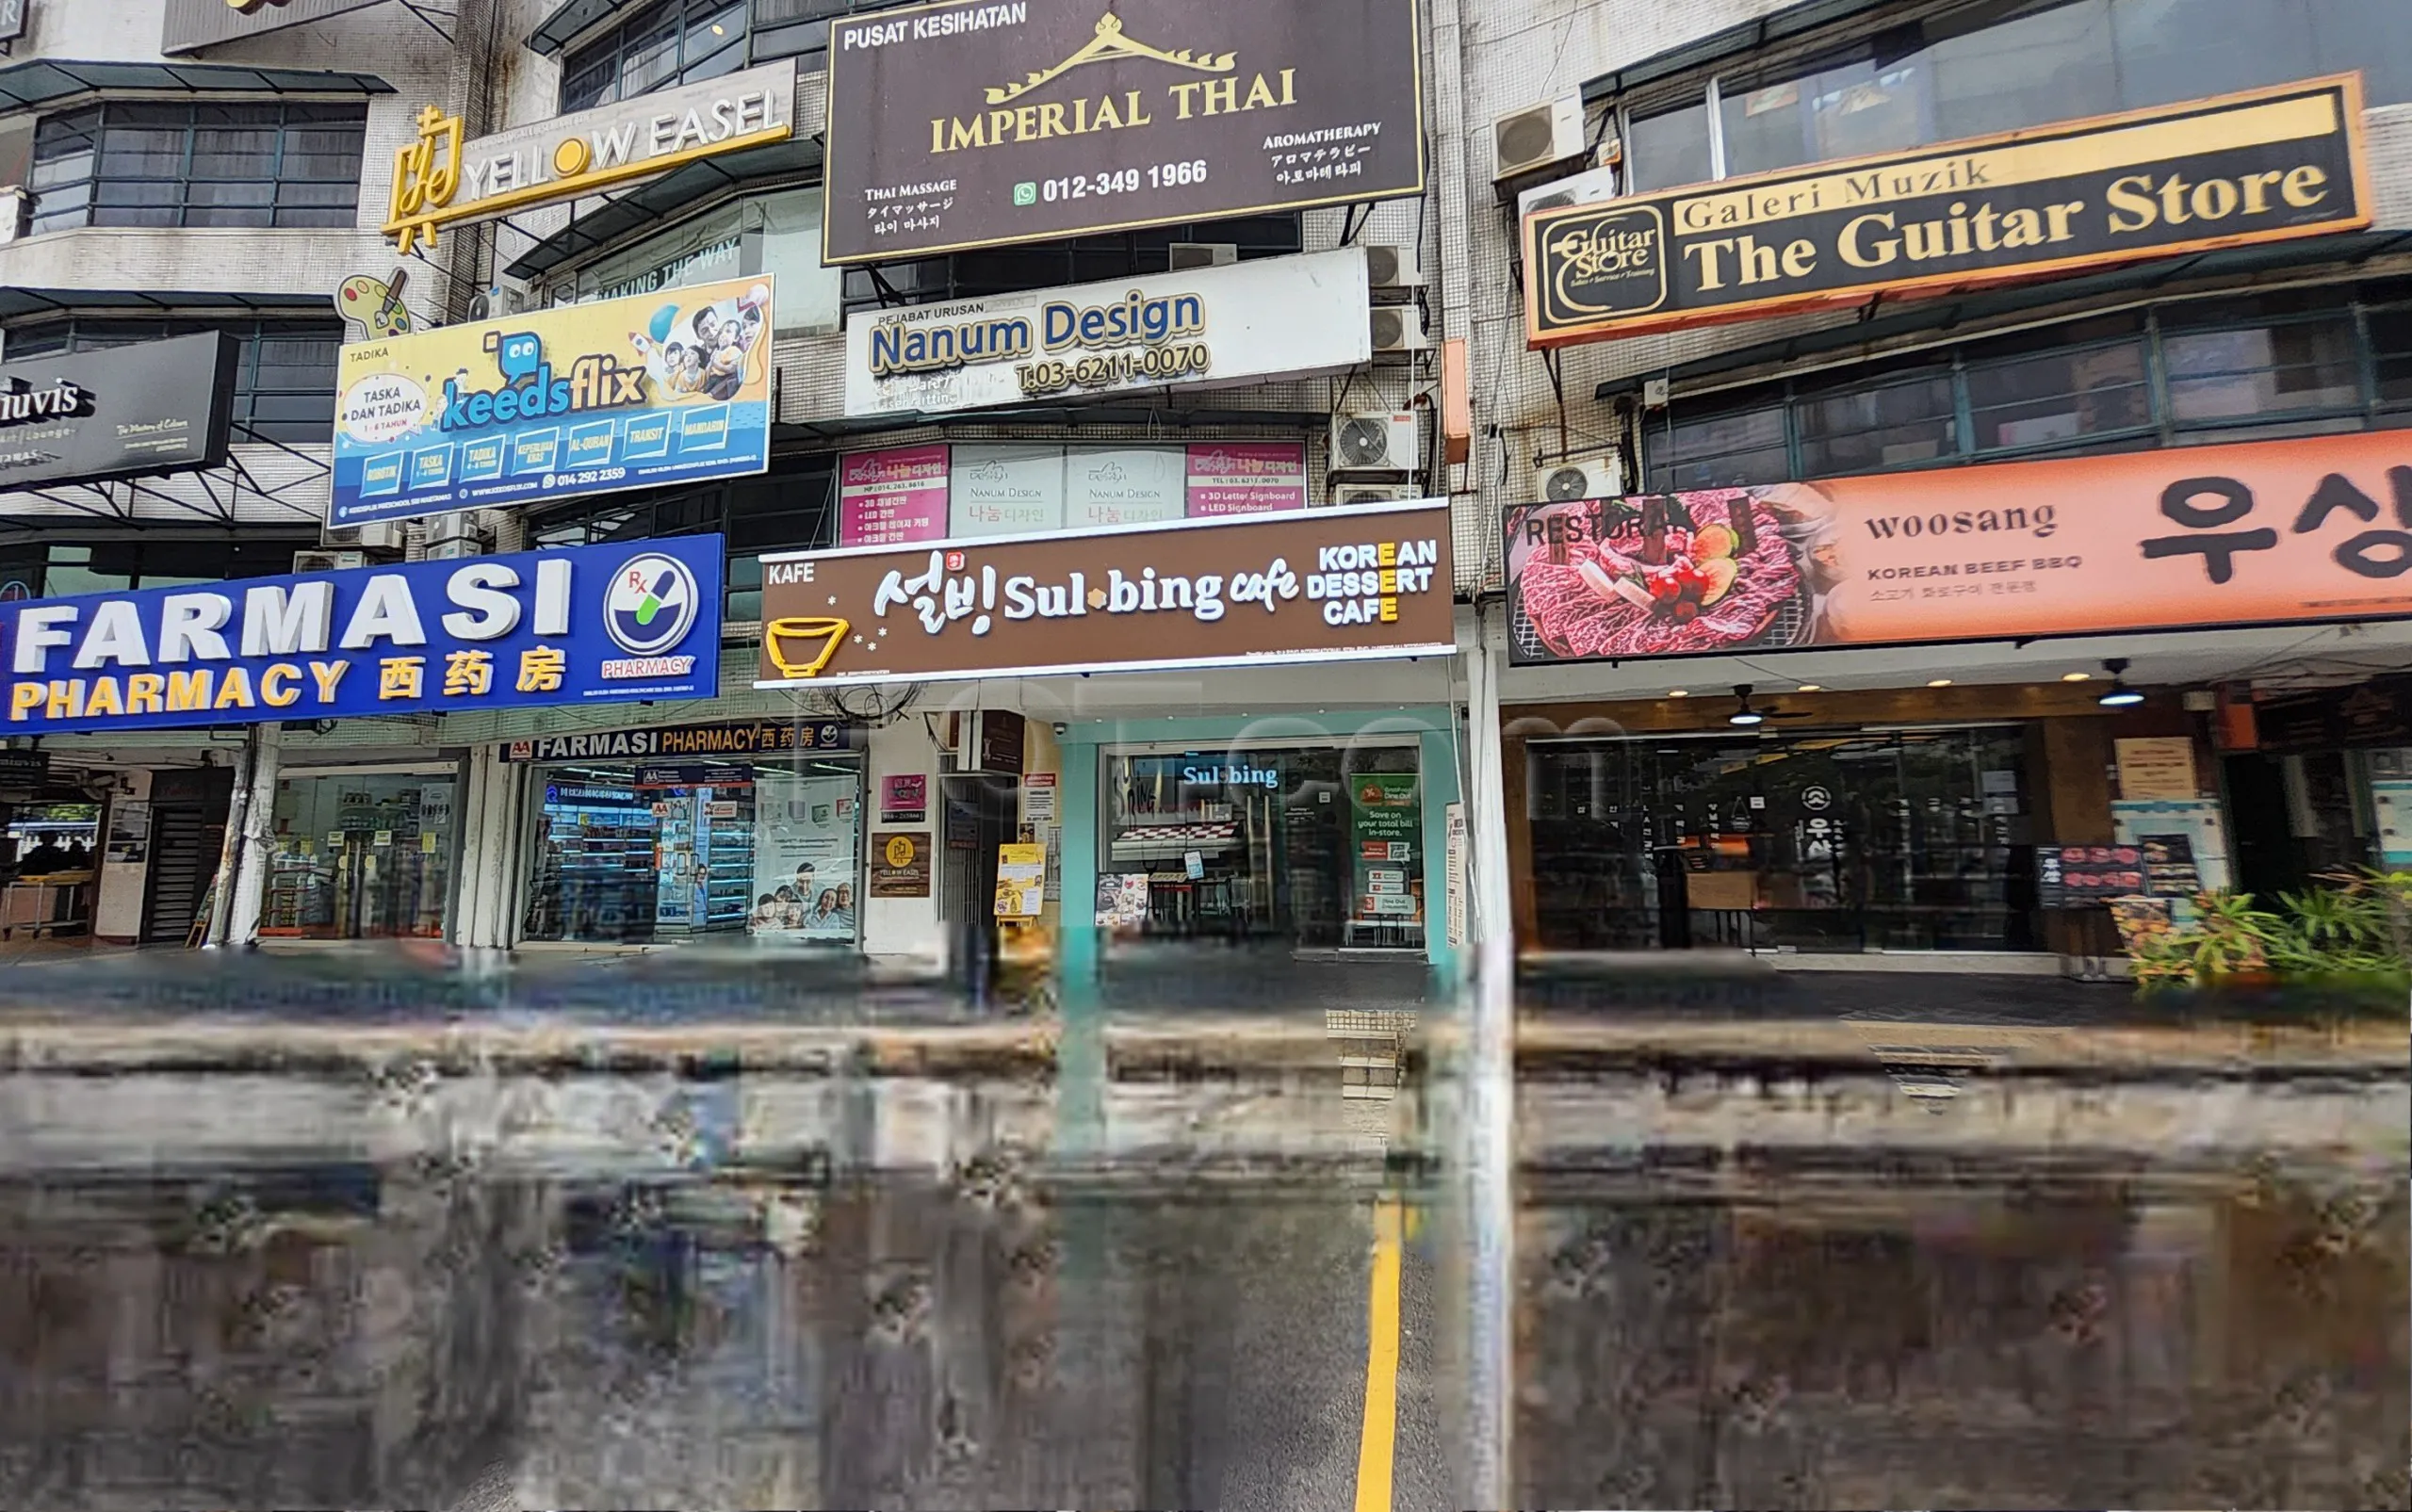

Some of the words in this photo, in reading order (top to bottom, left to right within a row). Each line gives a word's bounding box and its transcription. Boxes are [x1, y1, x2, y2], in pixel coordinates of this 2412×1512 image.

[843, 21, 907, 51] PUSAT
[913, 1, 1027, 40] KESIHATAN
[929, 90, 1151, 154] IMPERIAL
[1169, 68, 1297, 120] THAI
[464, 120, 639, 201] YELLOW
[648, 88, 785, 158] EASEL
[1263, 121, 1381, 150] AROMATHERAPY
[865, 187, 896, 202] THAI
[900, 178, 957, 197] MASSAGE
[1042, 165, 1141, 203] 012-349
[1147, 158, 1208, 190] 1966
[1682, 179, 1822, 234] Galeri
[1844, 157, 1992, 206] Muzik
[1683, 229, 1820, 293] The
[1836, 195, 2085, 272] Guitar
[2107, 158, 2329, 237] Store
[662, 254, 695, 282] THE
[700, 236, 739, 270] WAY
[1551, 228, 1656, 260] Guitar
[1574, 248, 1649, 280] Store
[877, 305, 930, 326] PEJABAT
[933, 301, 986, 321] URUSAN
[869, 314, 1035, 377] Nanum
[1041, 287, 1206, 354] Design
[350, 346, 390, 364] TADIKA
[363, 386, 401, 404] TASKA
[441, 354, 646, 434] keedsflix
[350, 407, 376, 422] DAN
[378, 398, 421, 417] TADIKA
[381, 418, 408, 430] TAHUN
[629, 427, 664, 444] TRANSIT
[418, 454, 444, 469] TASKA
[557, 475, 577, 487] 014
[578, 472, 598, 483] 292
[599, 467, 626, 482] 2359
[1208, 504, 1226, 512] LED
[1228, 502, 1273, 513] Signboard
[1222, 492, 1247, 500] Letter
[1249, 491, 1296, 502] Signboard
[1864, 503, 2060, 540] woosang
[1318, 539, 1438, 572] KOREAN
[1867, 565, 1959, 581] KOREAN
[1964, 560, 2027, 575] BEEF
[2031, 555, 2083, 570] BBQ
[768, 562, 815, 586] KAFE
[1229, 558, 1300, 613] cafe
[1306, 567, 1434, 600] DESSERT
[12, 557, 573, 674] FARMASI
[1323, 596, 1399, 626] CAFE
[379, 645, 566, 701] 西药房
[601, 655, 696, 679] PHARMACY
[9, 659, 350, 722] PHARMACY
[538, 732, 658, 758] FARMASI
[661, 729, 758, 753] PHARMACY
[760, 726, 815, 748] 西药房
[1358, 821, 1377, 830] your
[1378, 820, 1399, 828] total
[1400, 819, 1413, 828] bill
